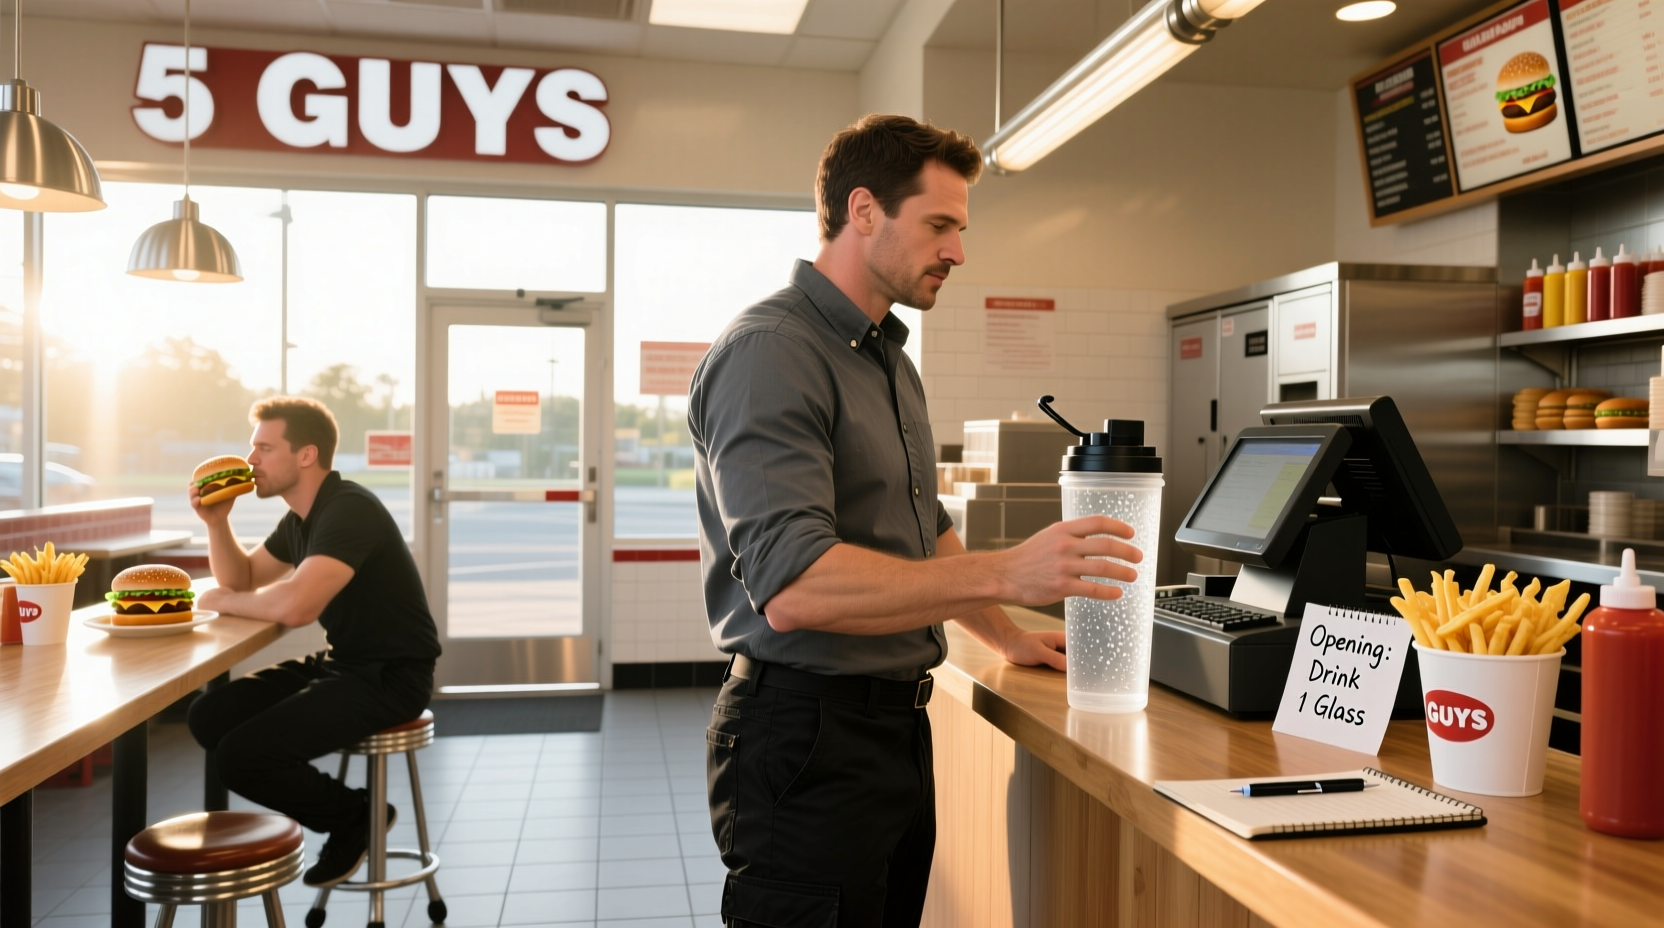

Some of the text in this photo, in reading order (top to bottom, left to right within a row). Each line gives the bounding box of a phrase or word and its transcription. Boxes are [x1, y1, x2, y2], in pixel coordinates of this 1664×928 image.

[132, 43, 611, 162] 5 GUYS
[1309, 624, 1393, 669] Opening:
[1308, 659, 1361, 690] Drink
[1298, 691, 1366, 726] 1 Glass
[1427, 700, 1488, 732] GUYS
